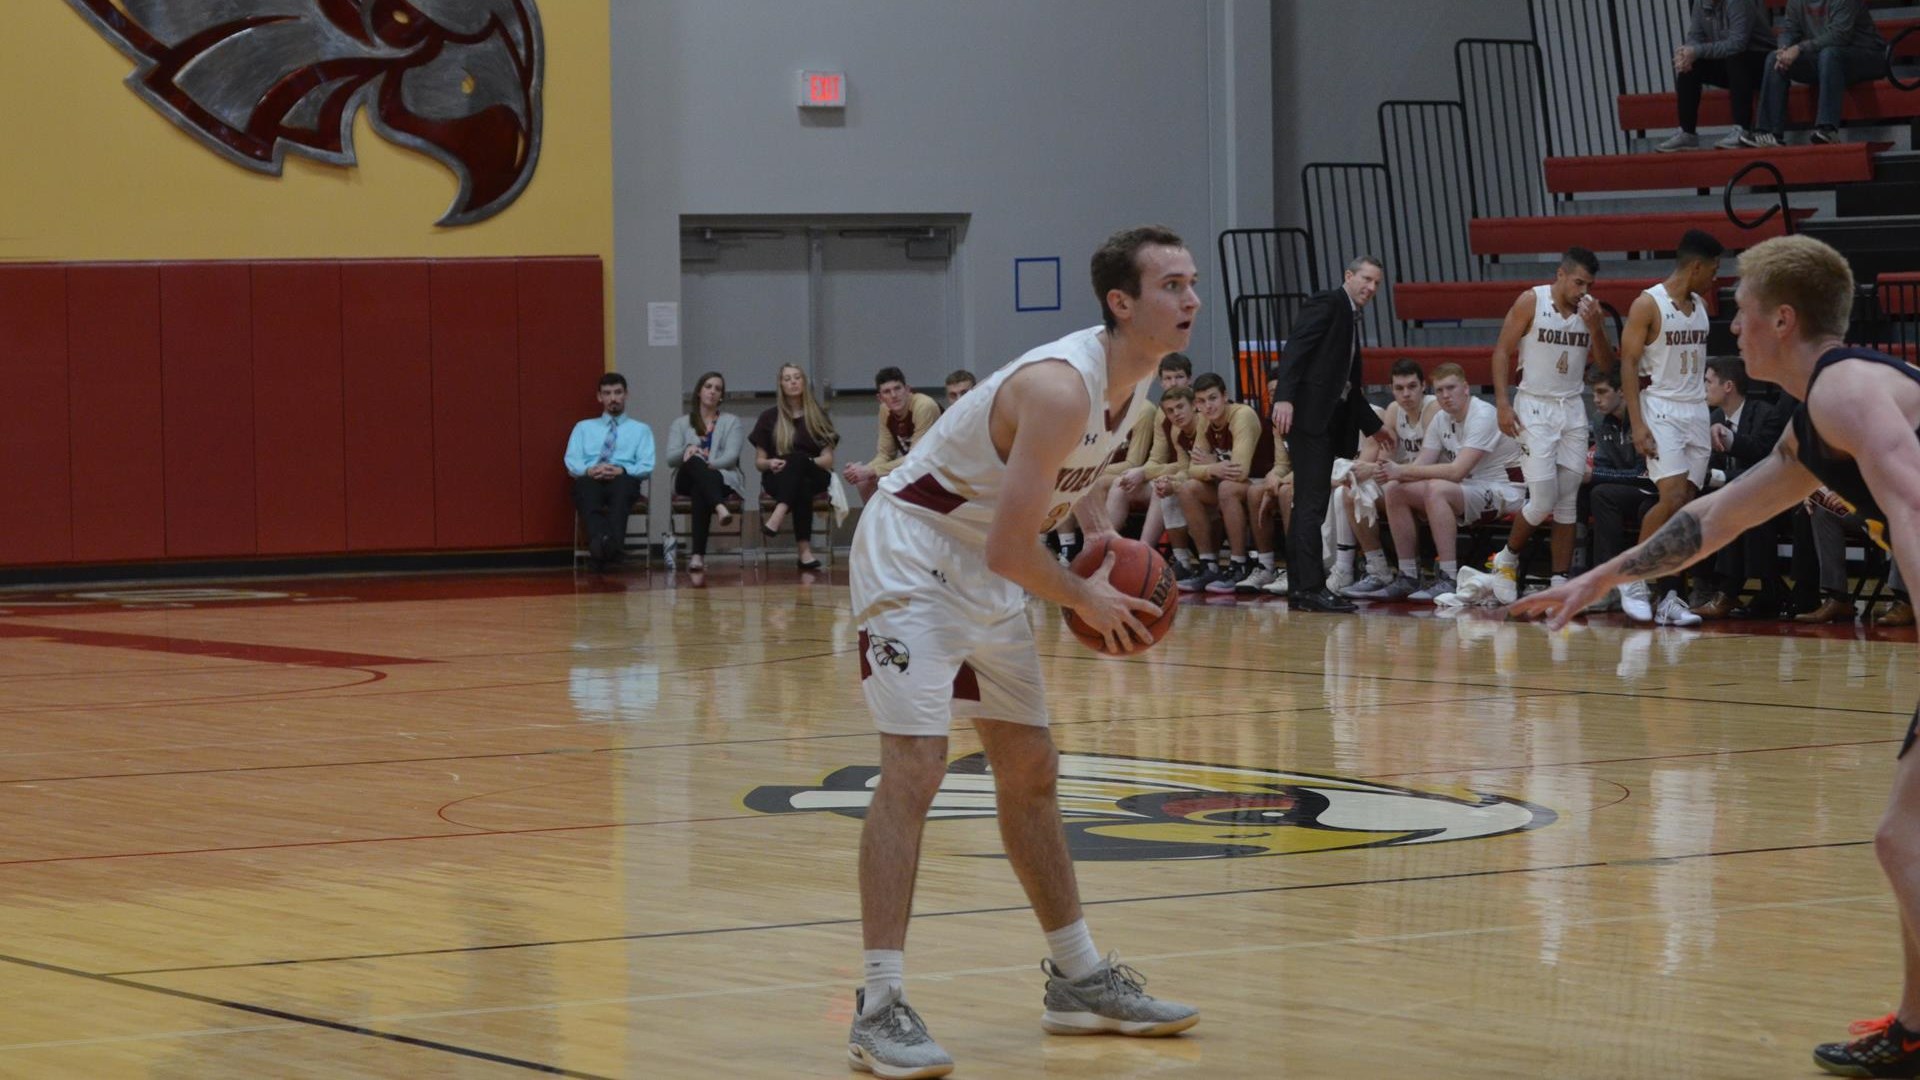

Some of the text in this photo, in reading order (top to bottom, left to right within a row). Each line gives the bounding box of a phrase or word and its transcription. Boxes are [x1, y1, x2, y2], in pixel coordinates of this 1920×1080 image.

[811, 75, 840, 101] EXIT
[1665, 329, 1707, 346] KOHAWK
[1556, 350, 1569, 374] 4
[1680, 350, 1698, 374] 11
